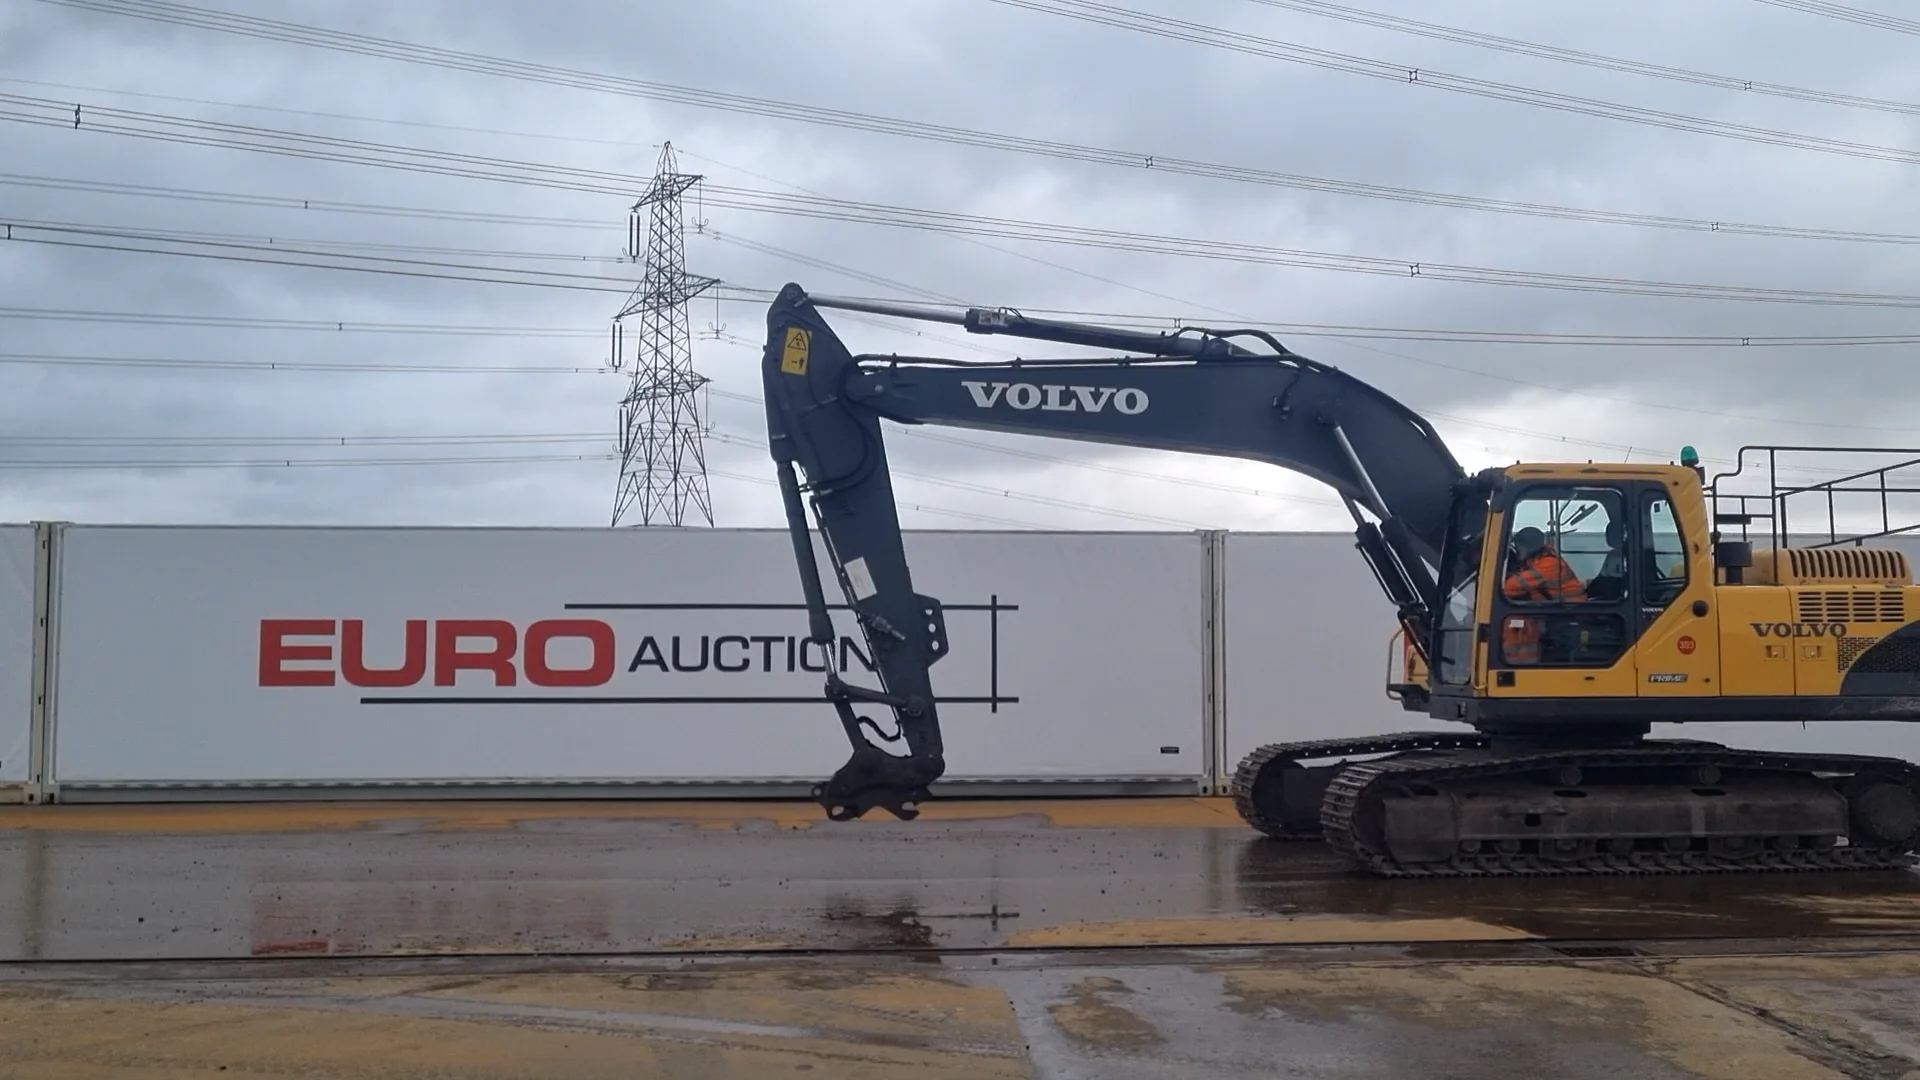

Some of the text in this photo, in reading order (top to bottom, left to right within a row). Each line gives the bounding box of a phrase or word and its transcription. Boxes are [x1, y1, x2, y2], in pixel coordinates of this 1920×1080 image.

[961, 381, 1149, 415] VOLVO
[1750, 623, 1847, 638] VOLVO
[259, 619, 615, 687] EURO
